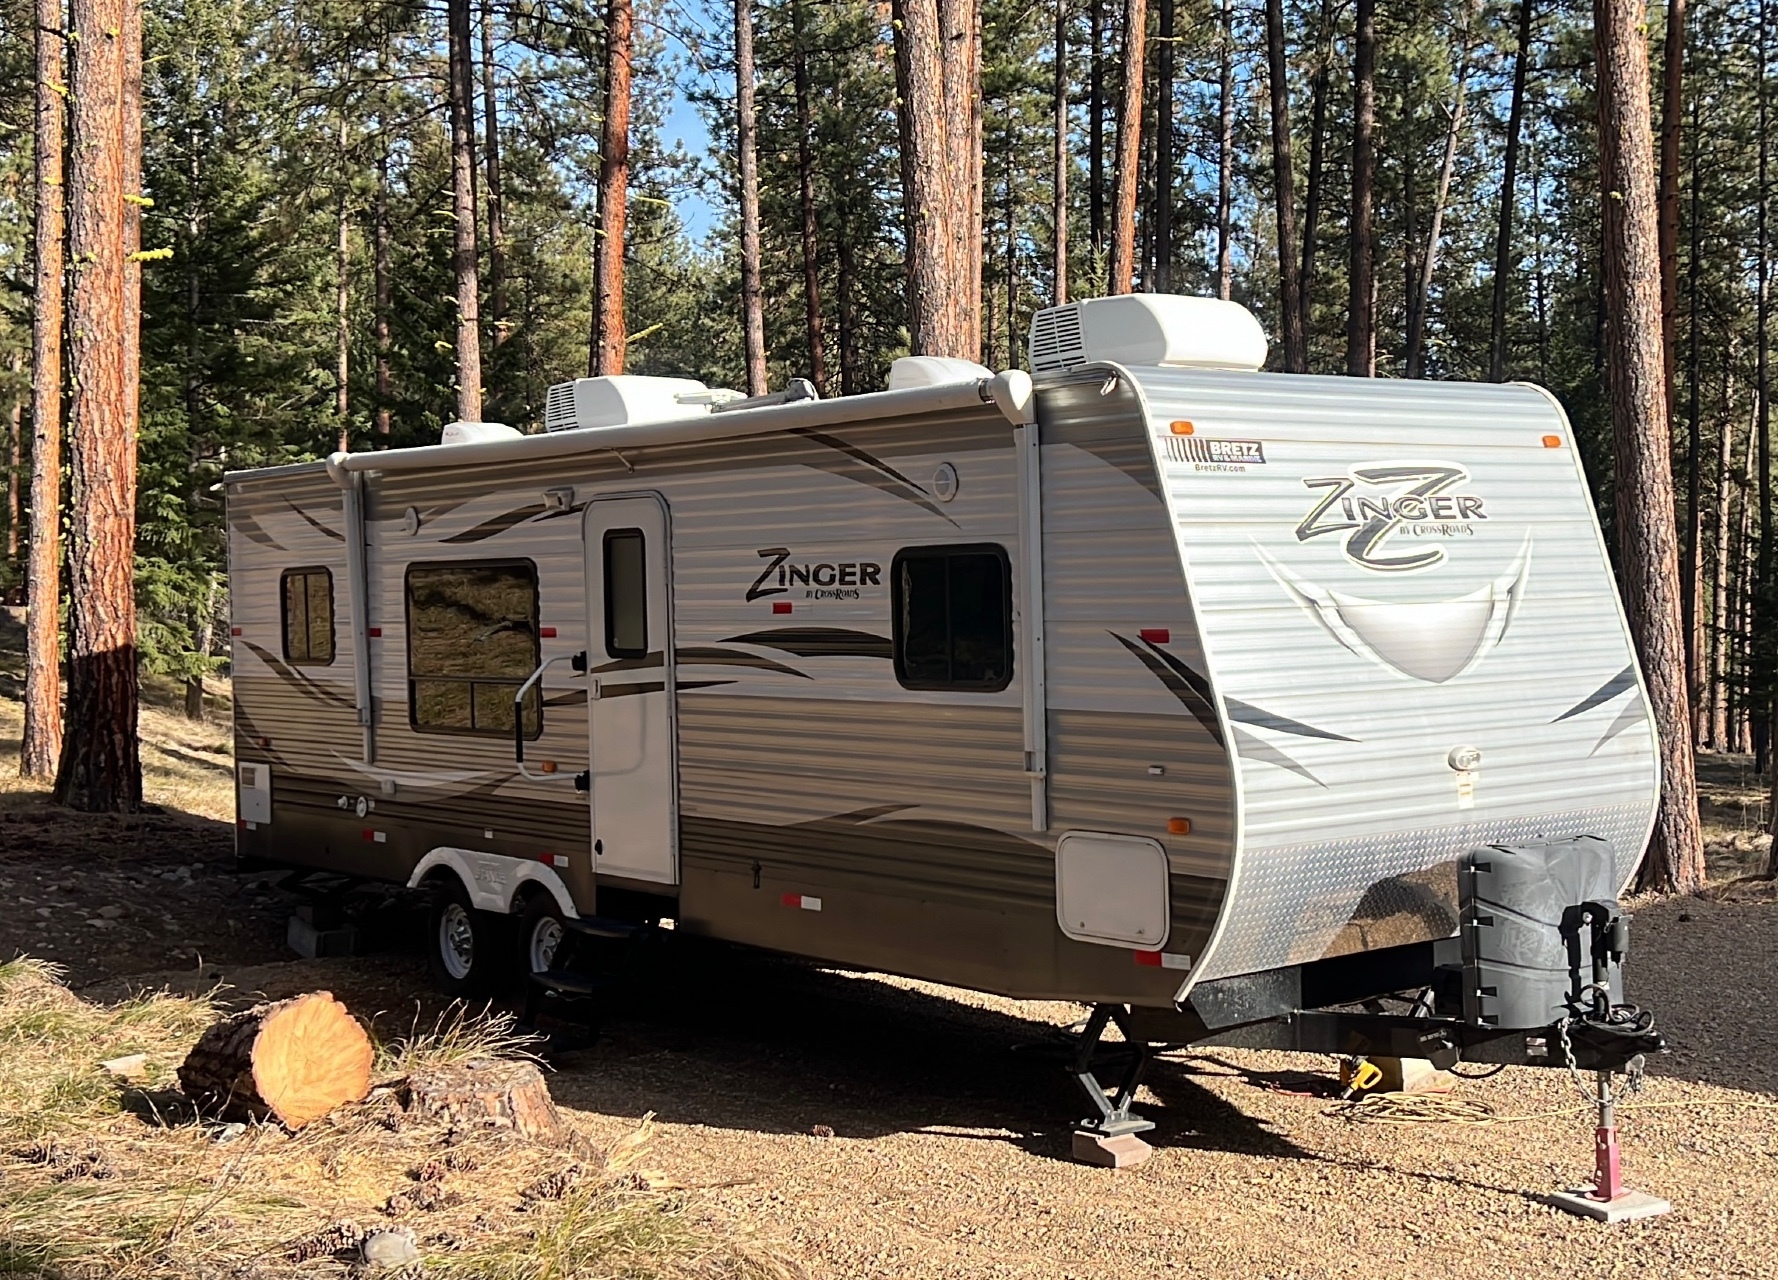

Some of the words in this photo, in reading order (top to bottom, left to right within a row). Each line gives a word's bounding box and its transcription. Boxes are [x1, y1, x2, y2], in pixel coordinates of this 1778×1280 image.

[1209, 441, 1260, 455] BRETZ
[1195, 463, 1246, 472] BretzRV.com
[1296, 478, 1488, 542] ZINGER
[1400, 526, 1410, 535] BY
[746, 548, 881, 602] ZINGER
